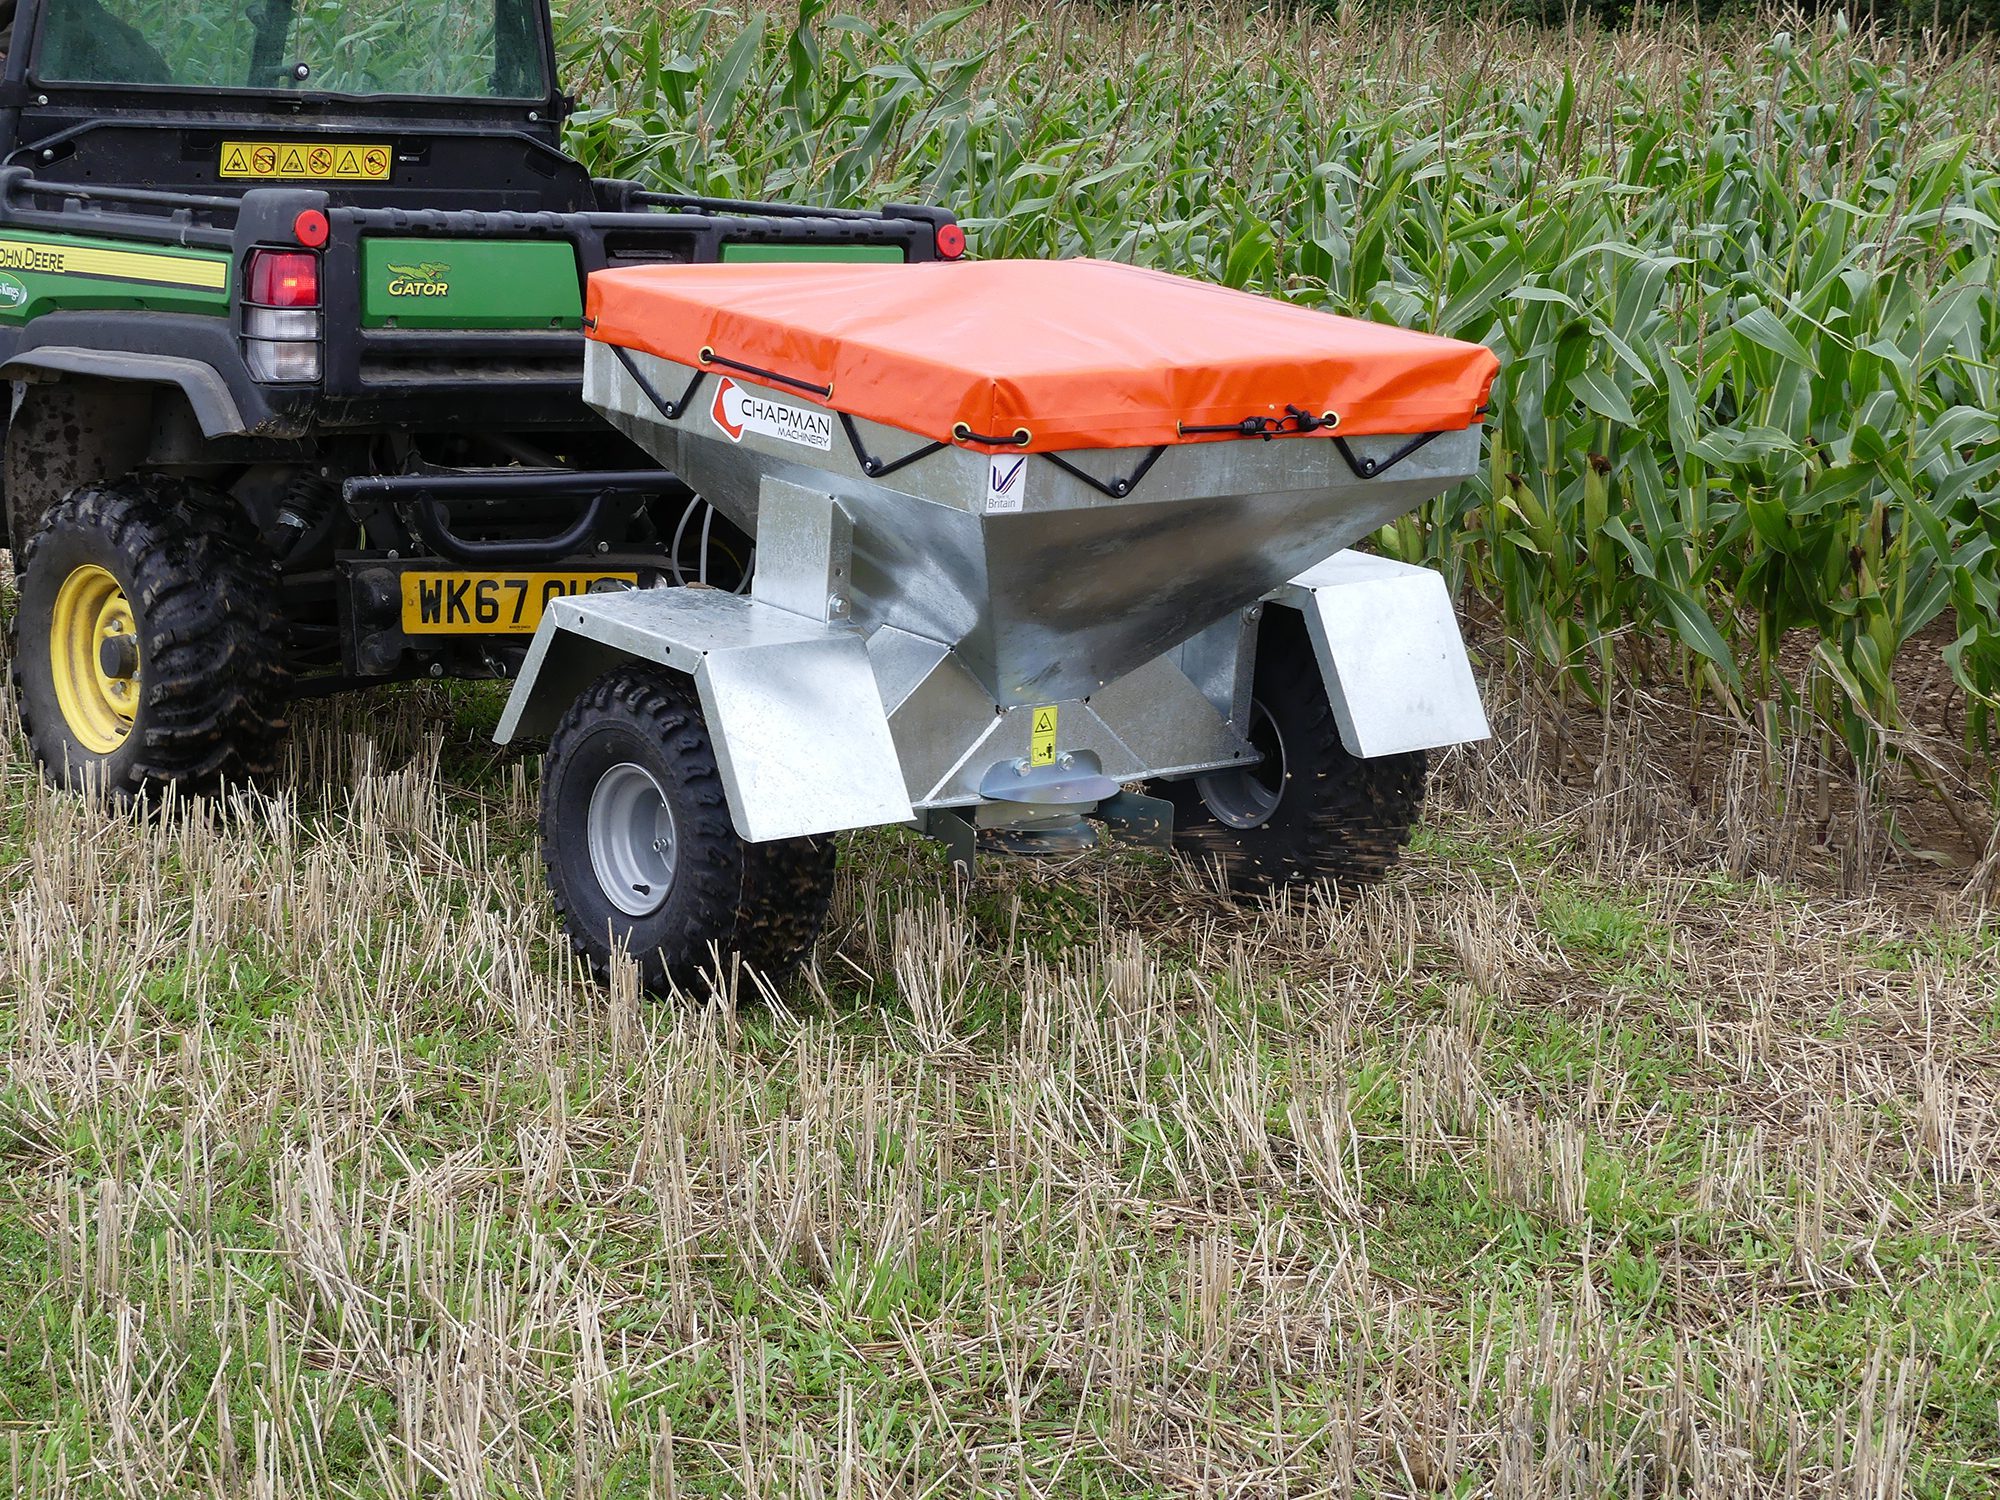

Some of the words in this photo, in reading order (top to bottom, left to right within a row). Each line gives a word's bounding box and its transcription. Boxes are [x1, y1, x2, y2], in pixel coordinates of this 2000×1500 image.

[0, 248, 23, 267] OHN
[25, 247, 65, 270] DEERE
[388, 279, 449, 296] GATOR
[741, 399, 830, 436] CHAPMAN
[777, 427, 829, 447] MACHINERY
[987, 498, 1016, 508] Britain
[419, 579, 528, 624] WK67
